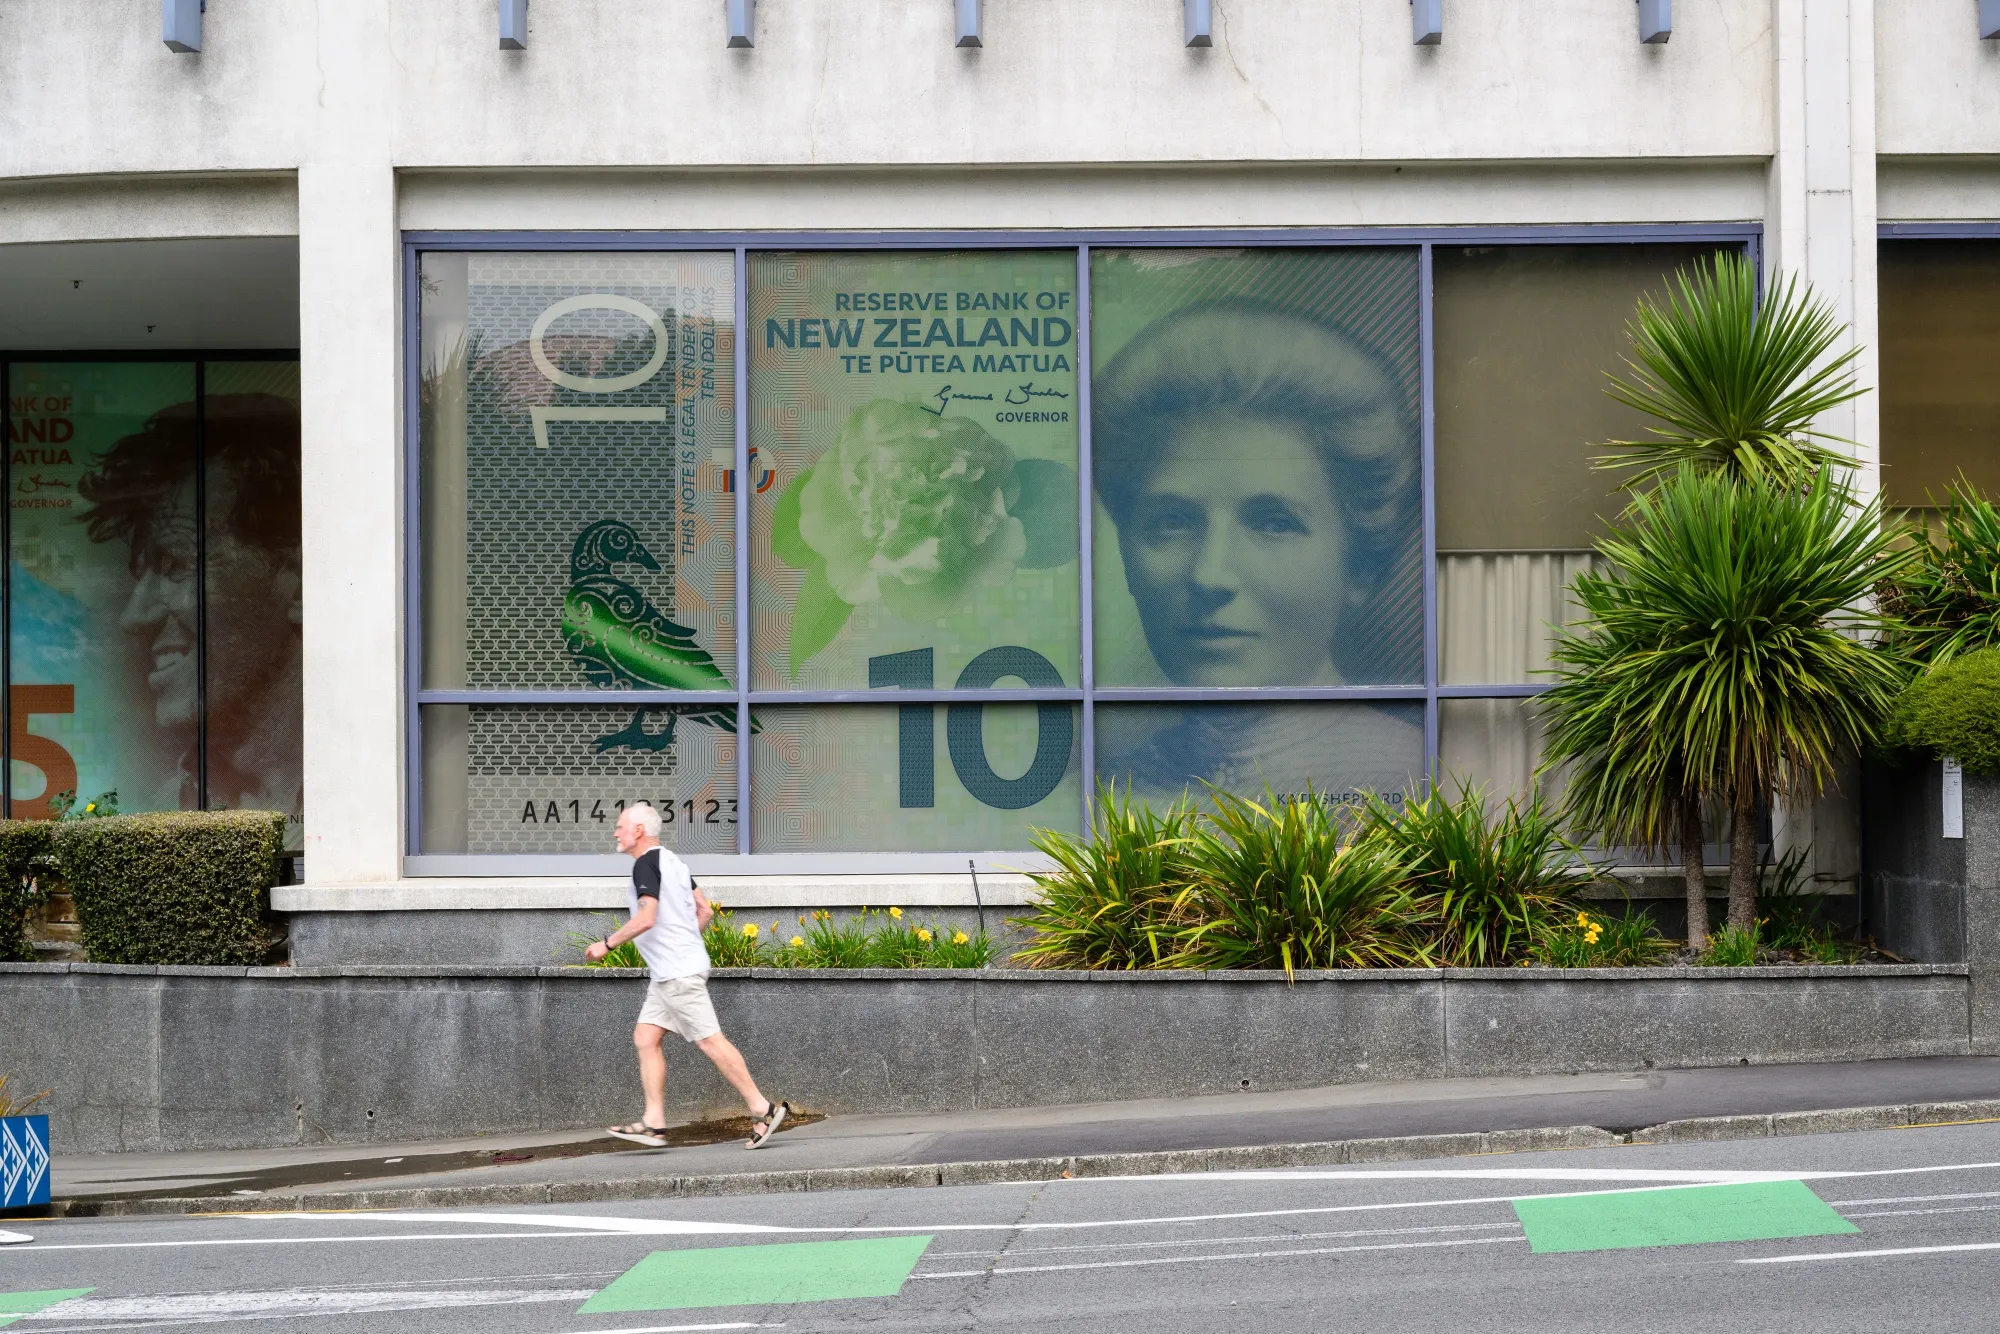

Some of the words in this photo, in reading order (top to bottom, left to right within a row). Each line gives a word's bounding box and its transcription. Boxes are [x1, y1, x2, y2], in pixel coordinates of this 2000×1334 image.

[682, 286, 697, 319] FOR
[835, 292, 948, 312] RESERVE
[956, 291, 1029, 311] BANK
[1036, 291, 1071, 310] OF
[701, 286, 715, 363] DOLLARS
[766, 318, 865, 349] NEW
[873, 317, 1072, 348] ZEALAND
[530, 293, 669, 449] 10
[682, 323, 697, 390] TENDER
[840, 355, 872, 374] TE
[879, 351, 966, 373] PŪTEA
[972, 354, 1071, 373] MATUA
[701, 366, 715, 400] TEN
[43, 396, 73, 412] OF
[681, 395, 697, 447] LEGAL
[995, 412, 1069, 423] GOVERNOR
[681, 450, 696, 464] IS
[681, 467, 696, 515] NOTE
[681, 519, 696, 557] THIS
[869, 645, 1074, 810] 10
[0, 684, 78, 820] 5
